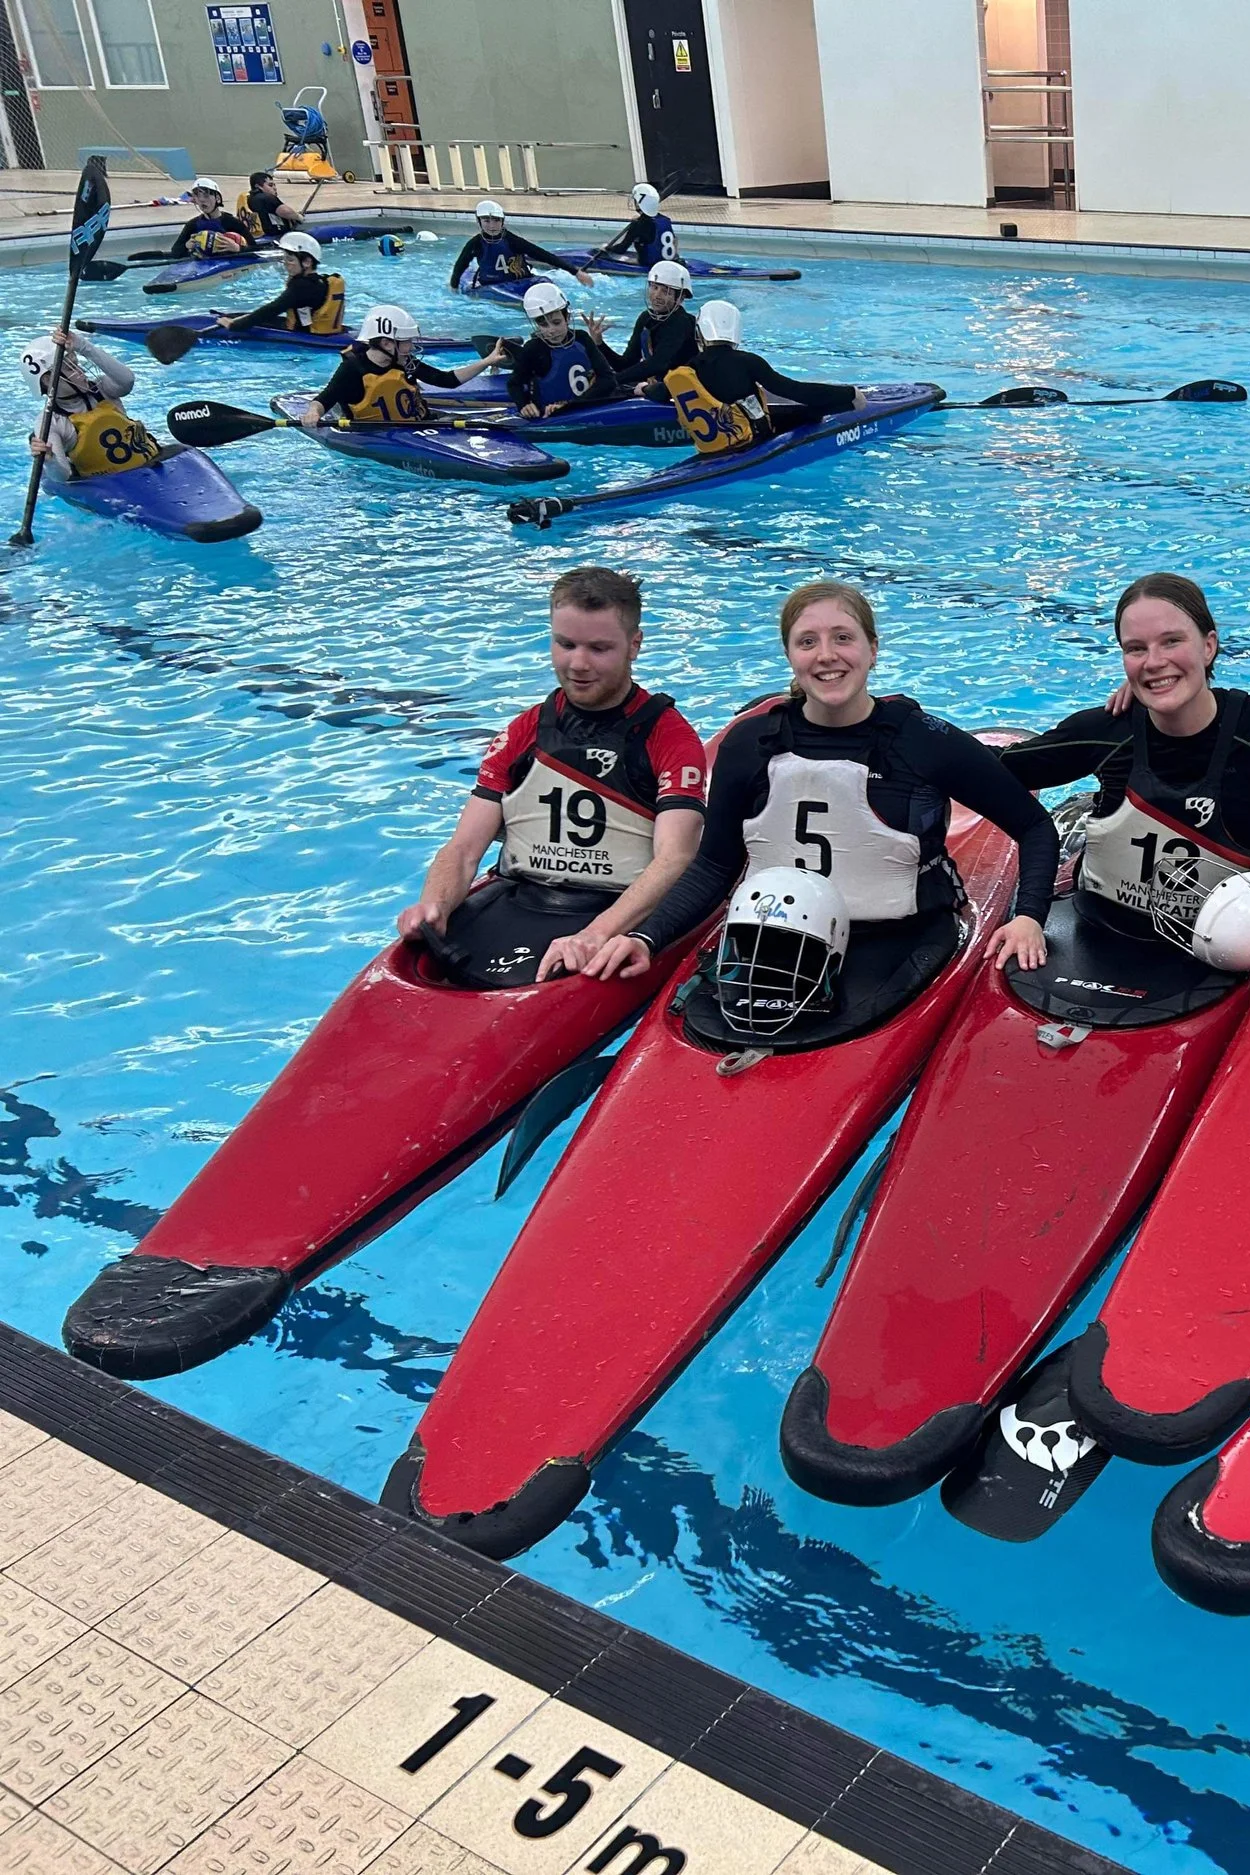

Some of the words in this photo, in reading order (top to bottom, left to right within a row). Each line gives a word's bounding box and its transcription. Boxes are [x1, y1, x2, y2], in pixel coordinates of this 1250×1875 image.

[659, 231, 677, 260] 8
[494, 253, 511, 275] 4
[375, 316, 393, 335] 10
[22, 354, 42, 376] 3
[568, 364, 590, 397] 6
[174, 404, 211, 422] nomad
[372, 388, 418, 422] 10
[676, 390, 718, 444] 5
[99, 428, 133, 465] 8
[412, 427, 440, 438] 10
[538, 785, 608, 849] 19
[531, 843, 610, 861] MANCHESTER
[794, 800, 833, 879] 5
[528, 856, 614, 876] WILDCATS
[1130, 831, 1202, 893] 13
[1120, 878, 1200, 905] MANCHESTER
